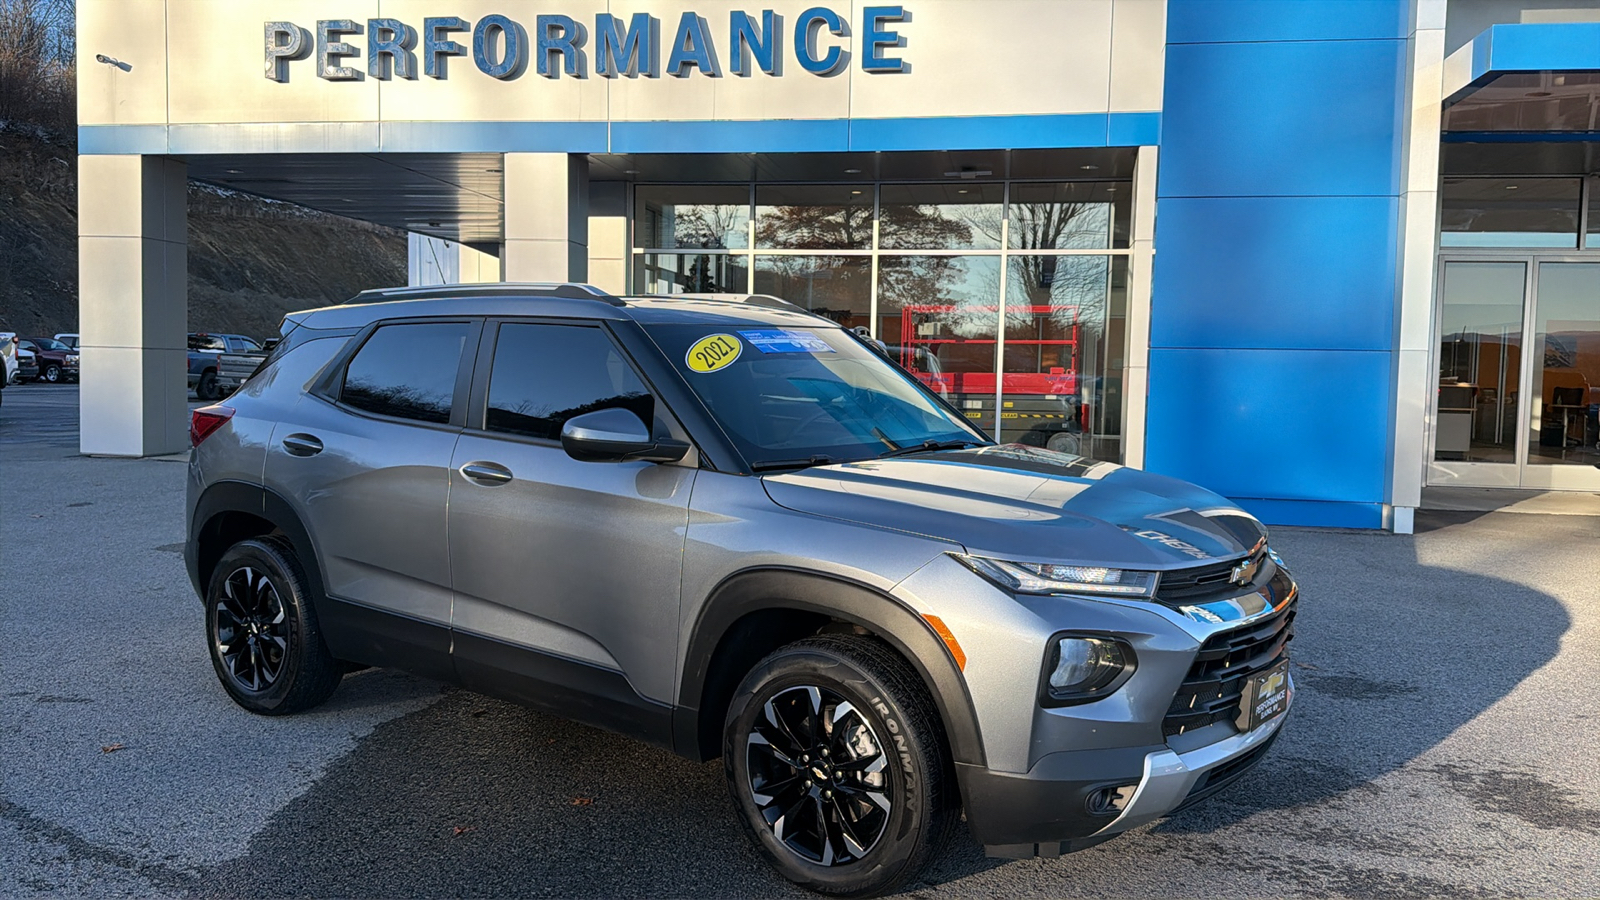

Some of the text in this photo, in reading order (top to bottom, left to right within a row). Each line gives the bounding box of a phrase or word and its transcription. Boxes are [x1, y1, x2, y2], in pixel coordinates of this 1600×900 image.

[264, 6, 910, 83] PERFORMANCE
[696, 336, 736, 369] 2021
[871, 696, 916, 811] IRONMAN
